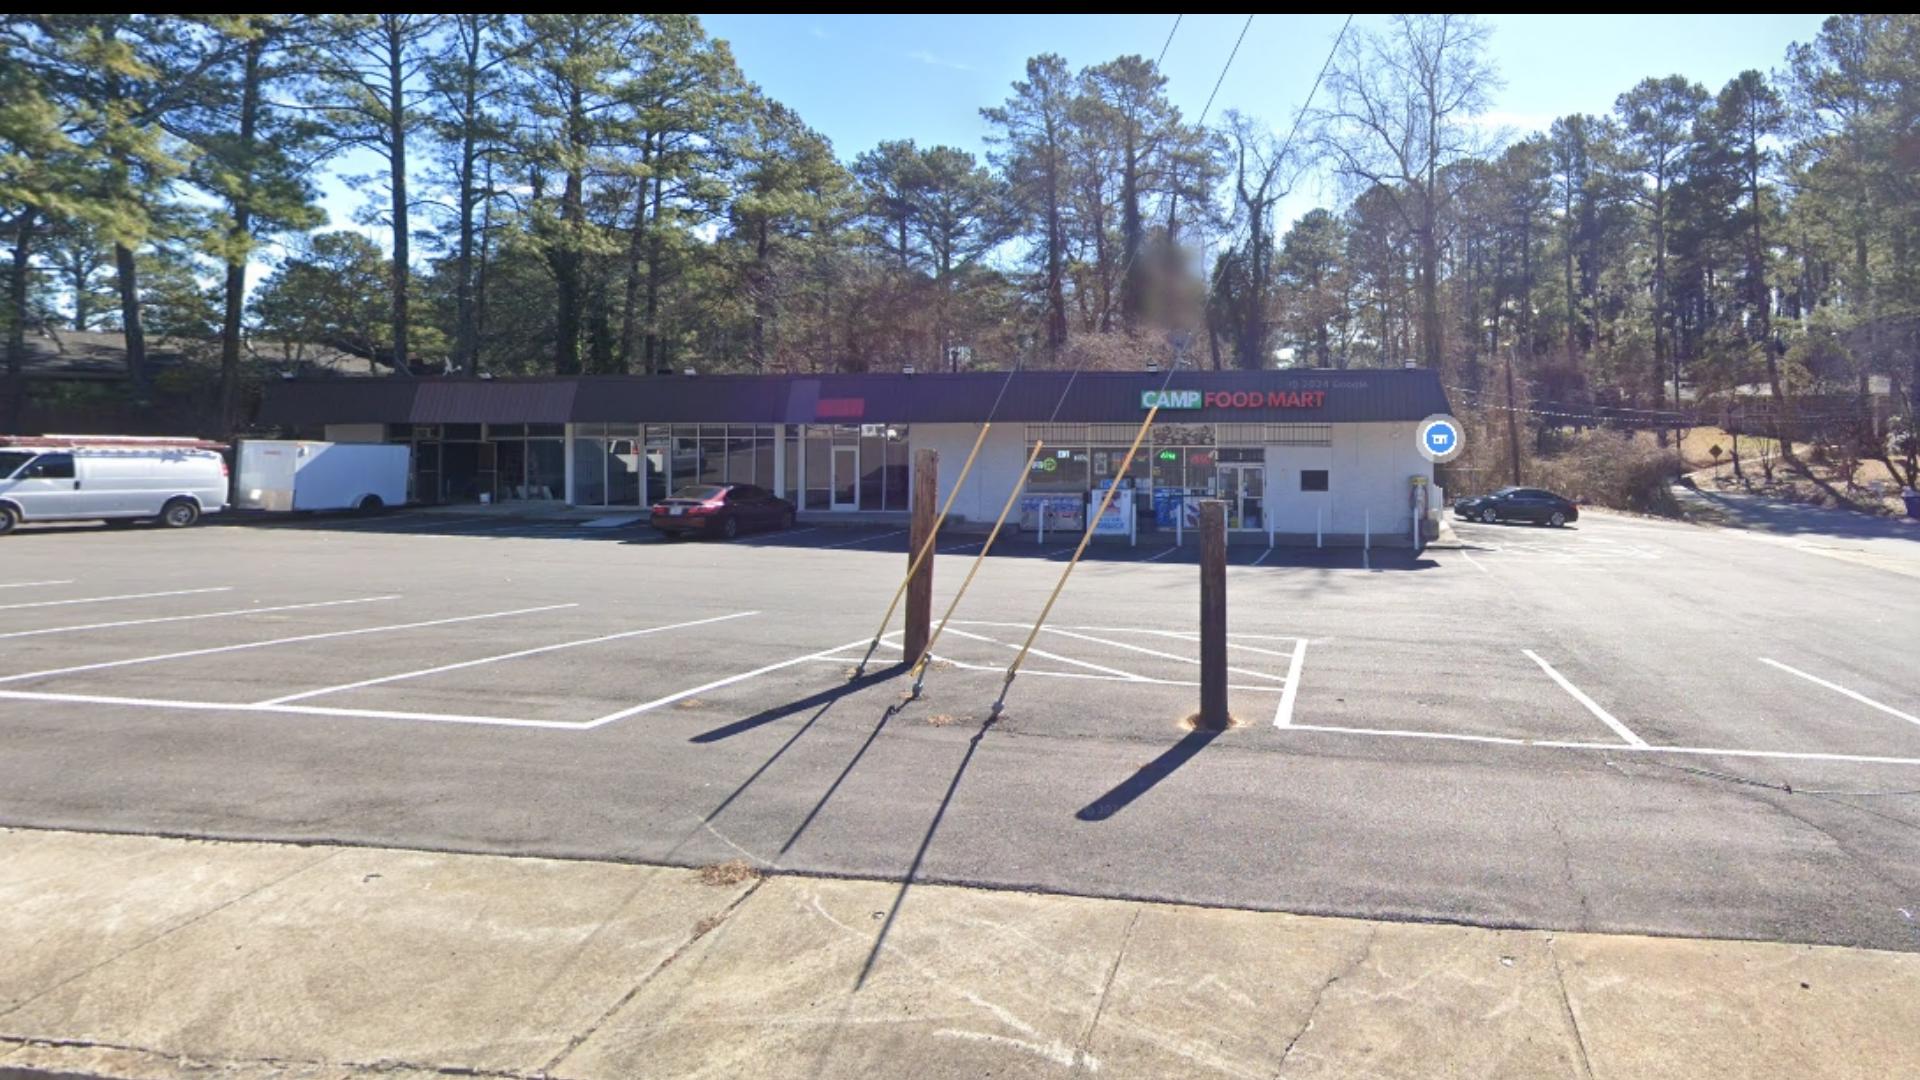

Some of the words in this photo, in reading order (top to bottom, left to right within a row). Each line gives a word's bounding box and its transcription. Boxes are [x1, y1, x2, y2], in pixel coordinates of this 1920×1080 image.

[1142, 391, 1200, 408] CAMP
[1204, 391, 1264, 408] FOOD
[1268, 390, 1325, 408] MART
